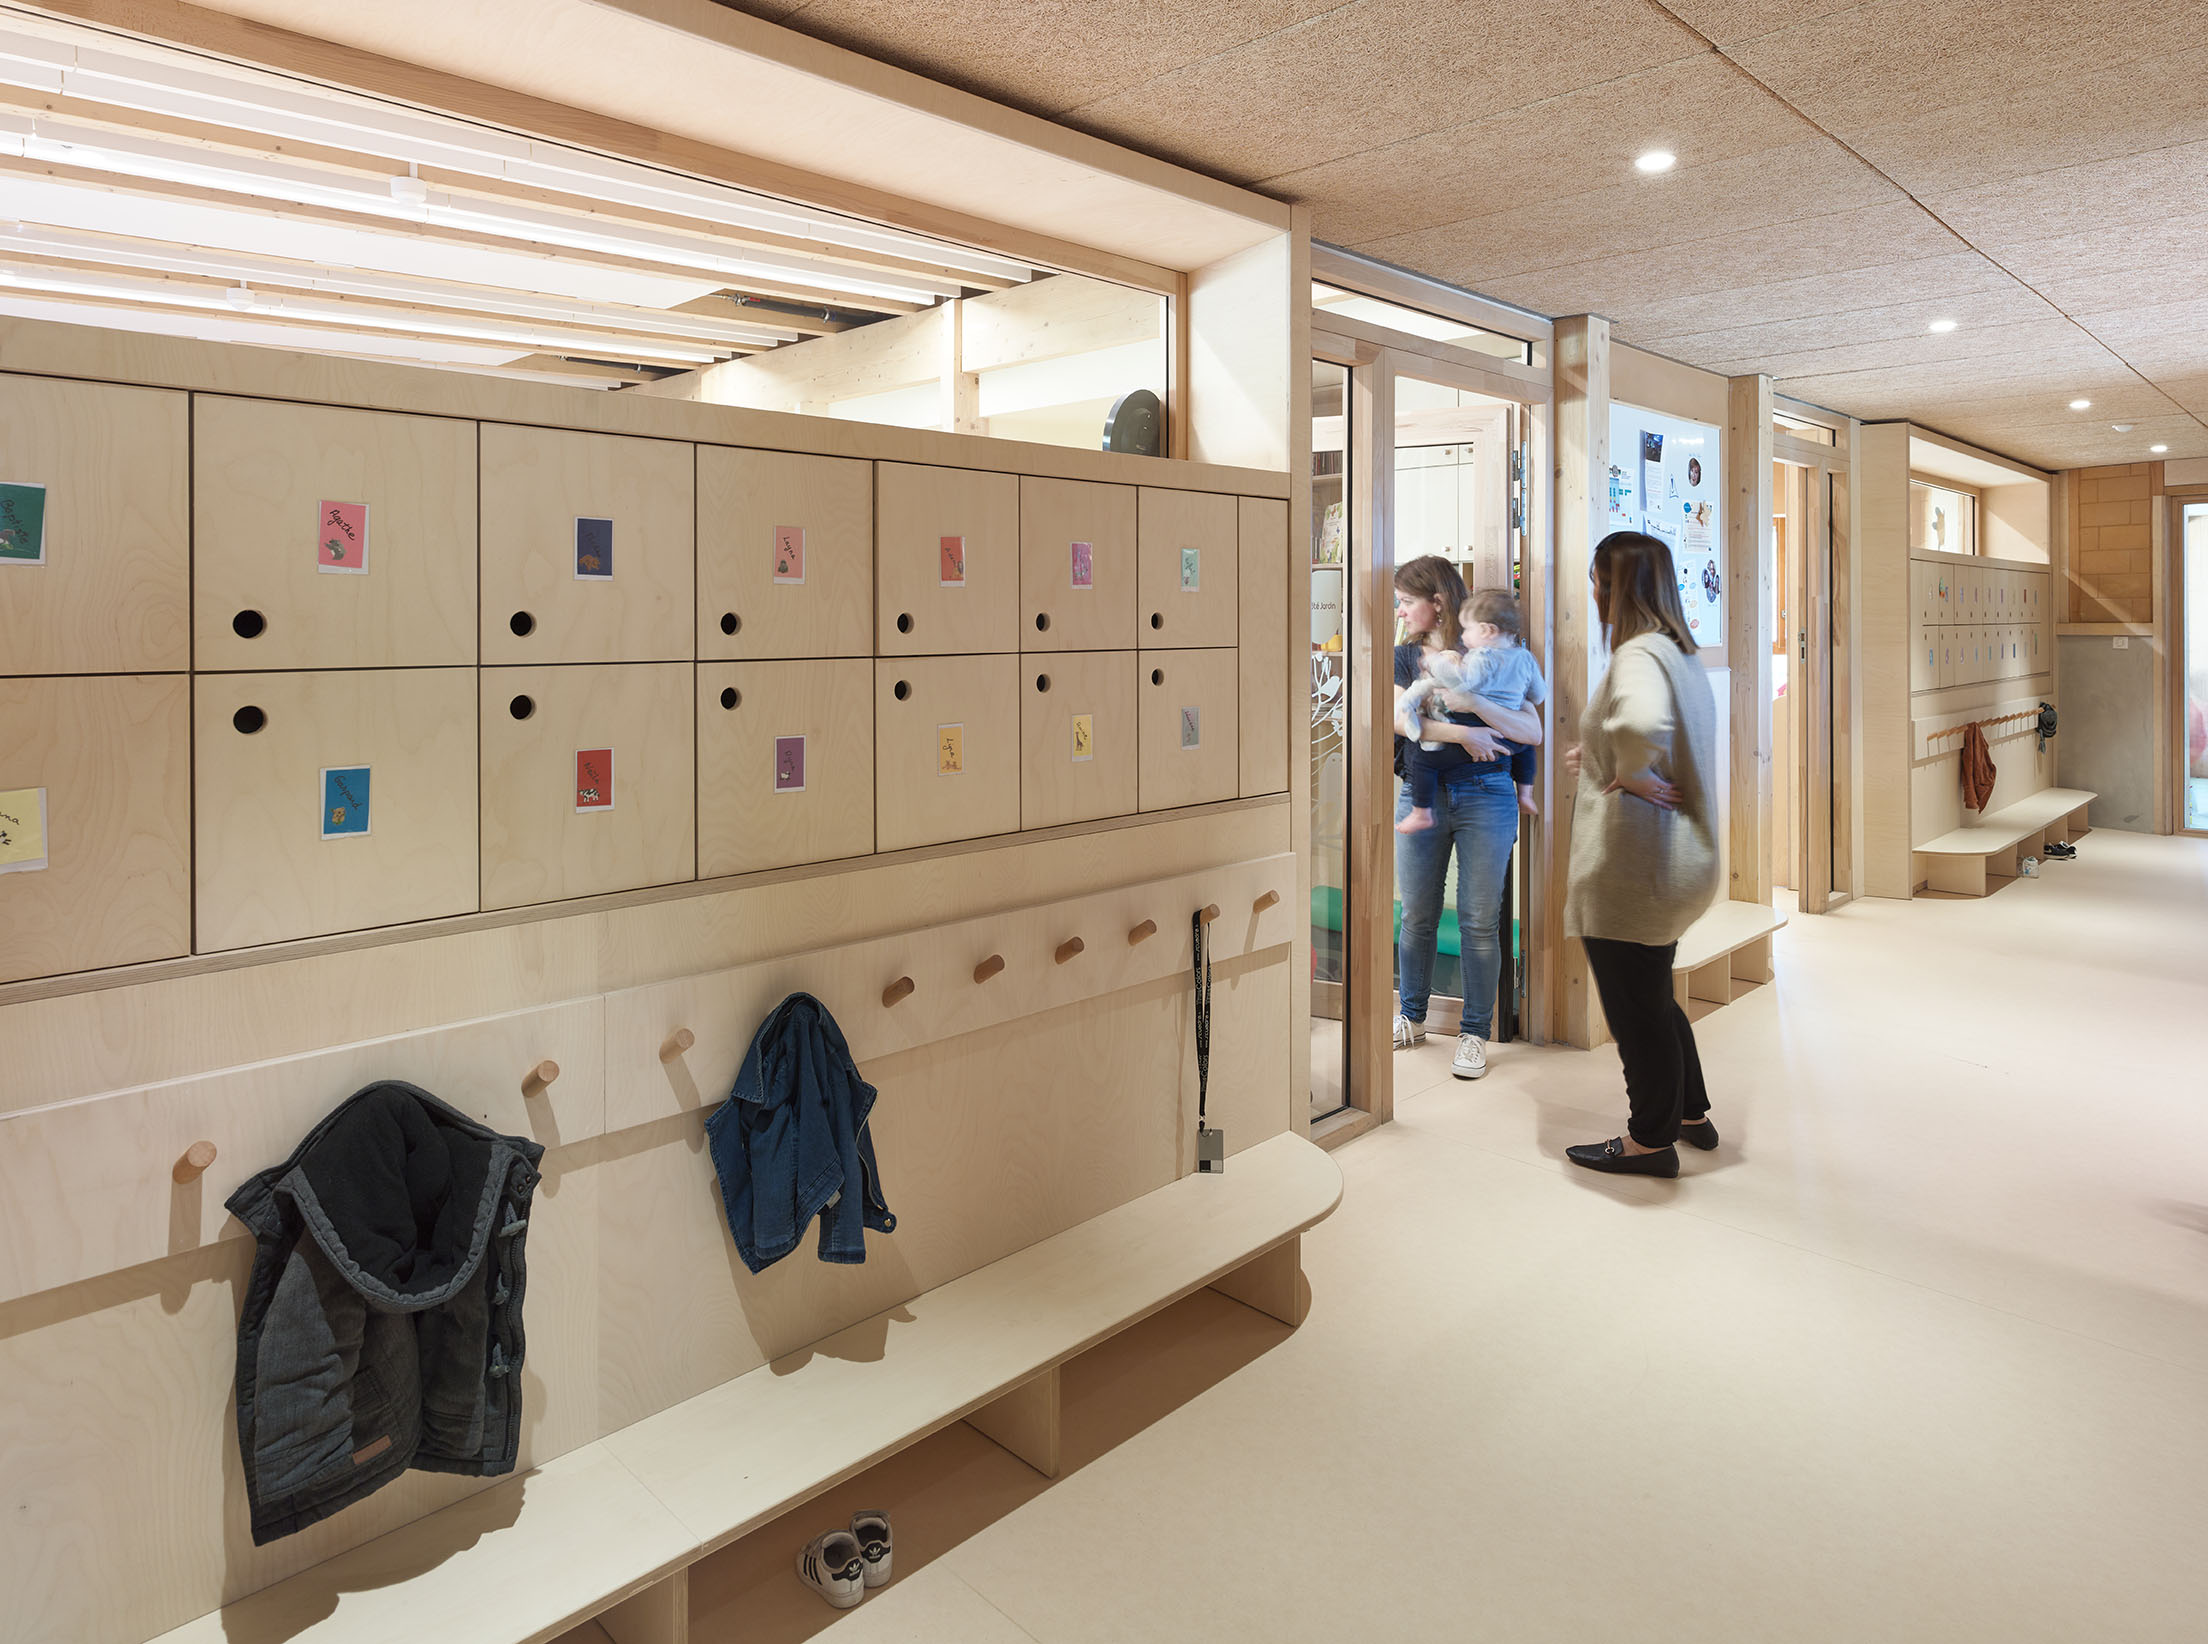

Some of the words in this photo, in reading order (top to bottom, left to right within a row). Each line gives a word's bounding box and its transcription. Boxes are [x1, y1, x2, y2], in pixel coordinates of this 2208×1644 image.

[1, 499, 29, 545] Baptiste
[327, 509, 355, 541] Agathe
[1320, 601, 1336, 610] Jardin
[334, 775, 363, 811] Gaspard
